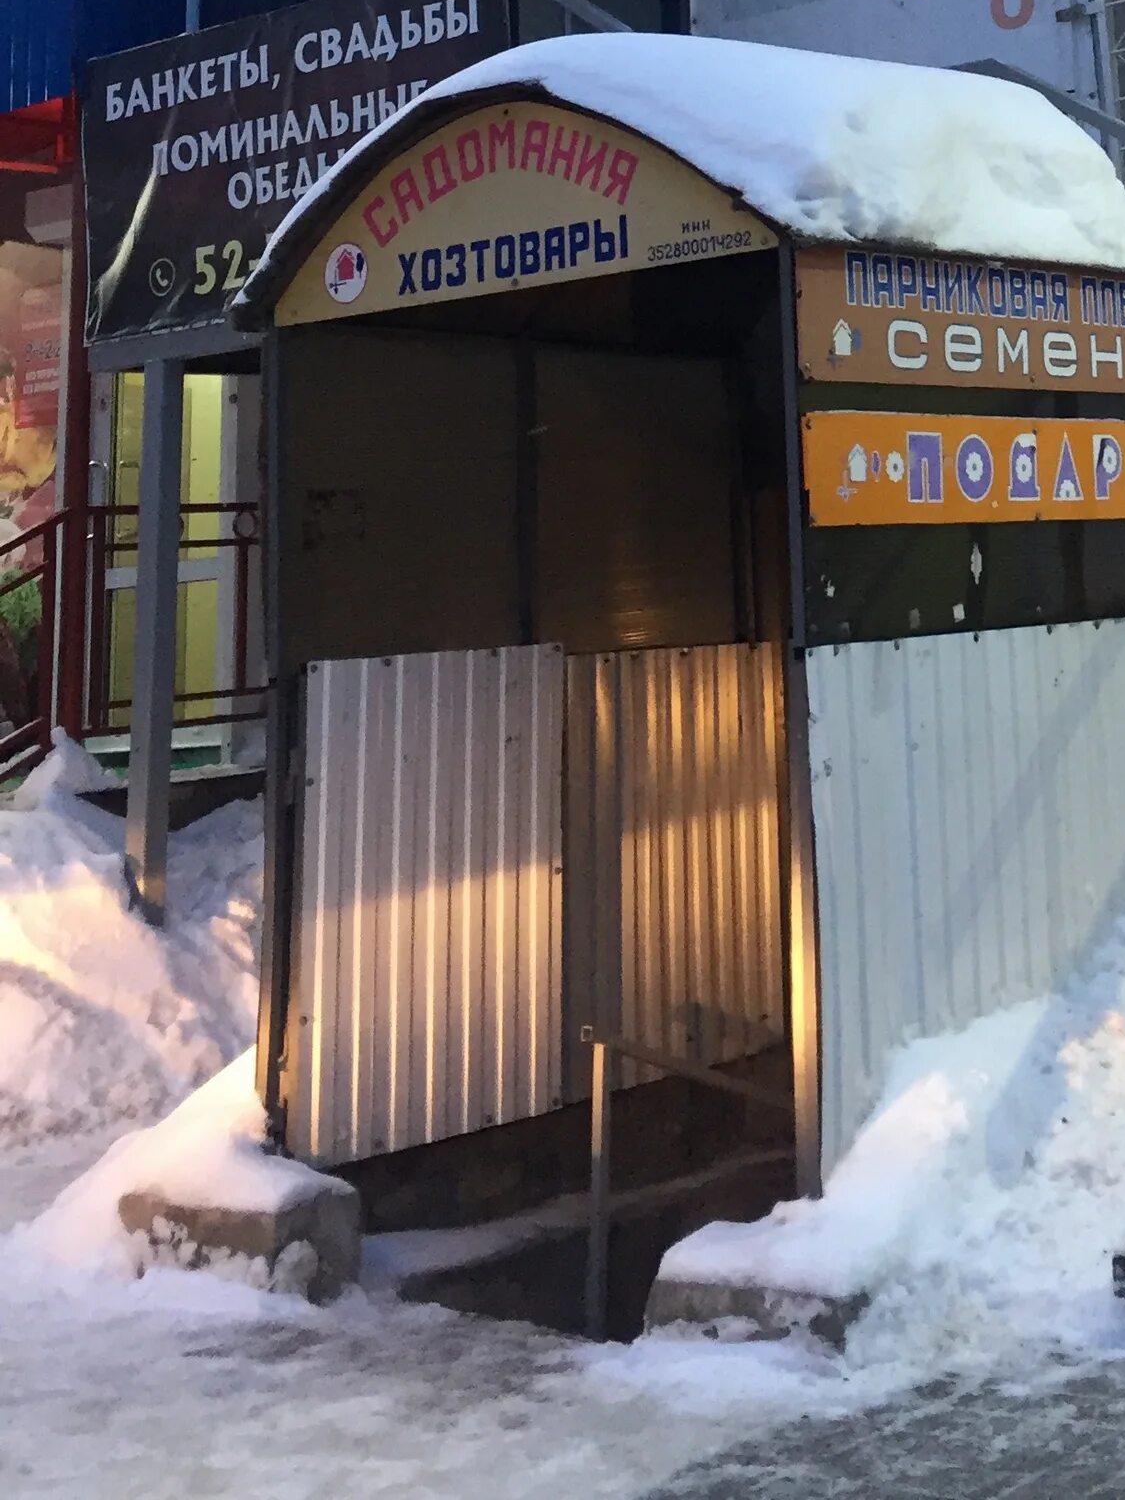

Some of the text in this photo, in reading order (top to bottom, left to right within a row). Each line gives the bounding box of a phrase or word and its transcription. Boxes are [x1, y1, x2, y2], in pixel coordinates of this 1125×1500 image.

[106, 44, 280, 122] БАНКЕТЫ,
[363, 119, 639, 248] САДОМАНИЯ
[398, 215, 629, 295] ХОЗТОВАРЫ
[648, 231, 752, 261] 352800014292
[845, 250, 1070, 323] ПАРНИКОВАЯ
